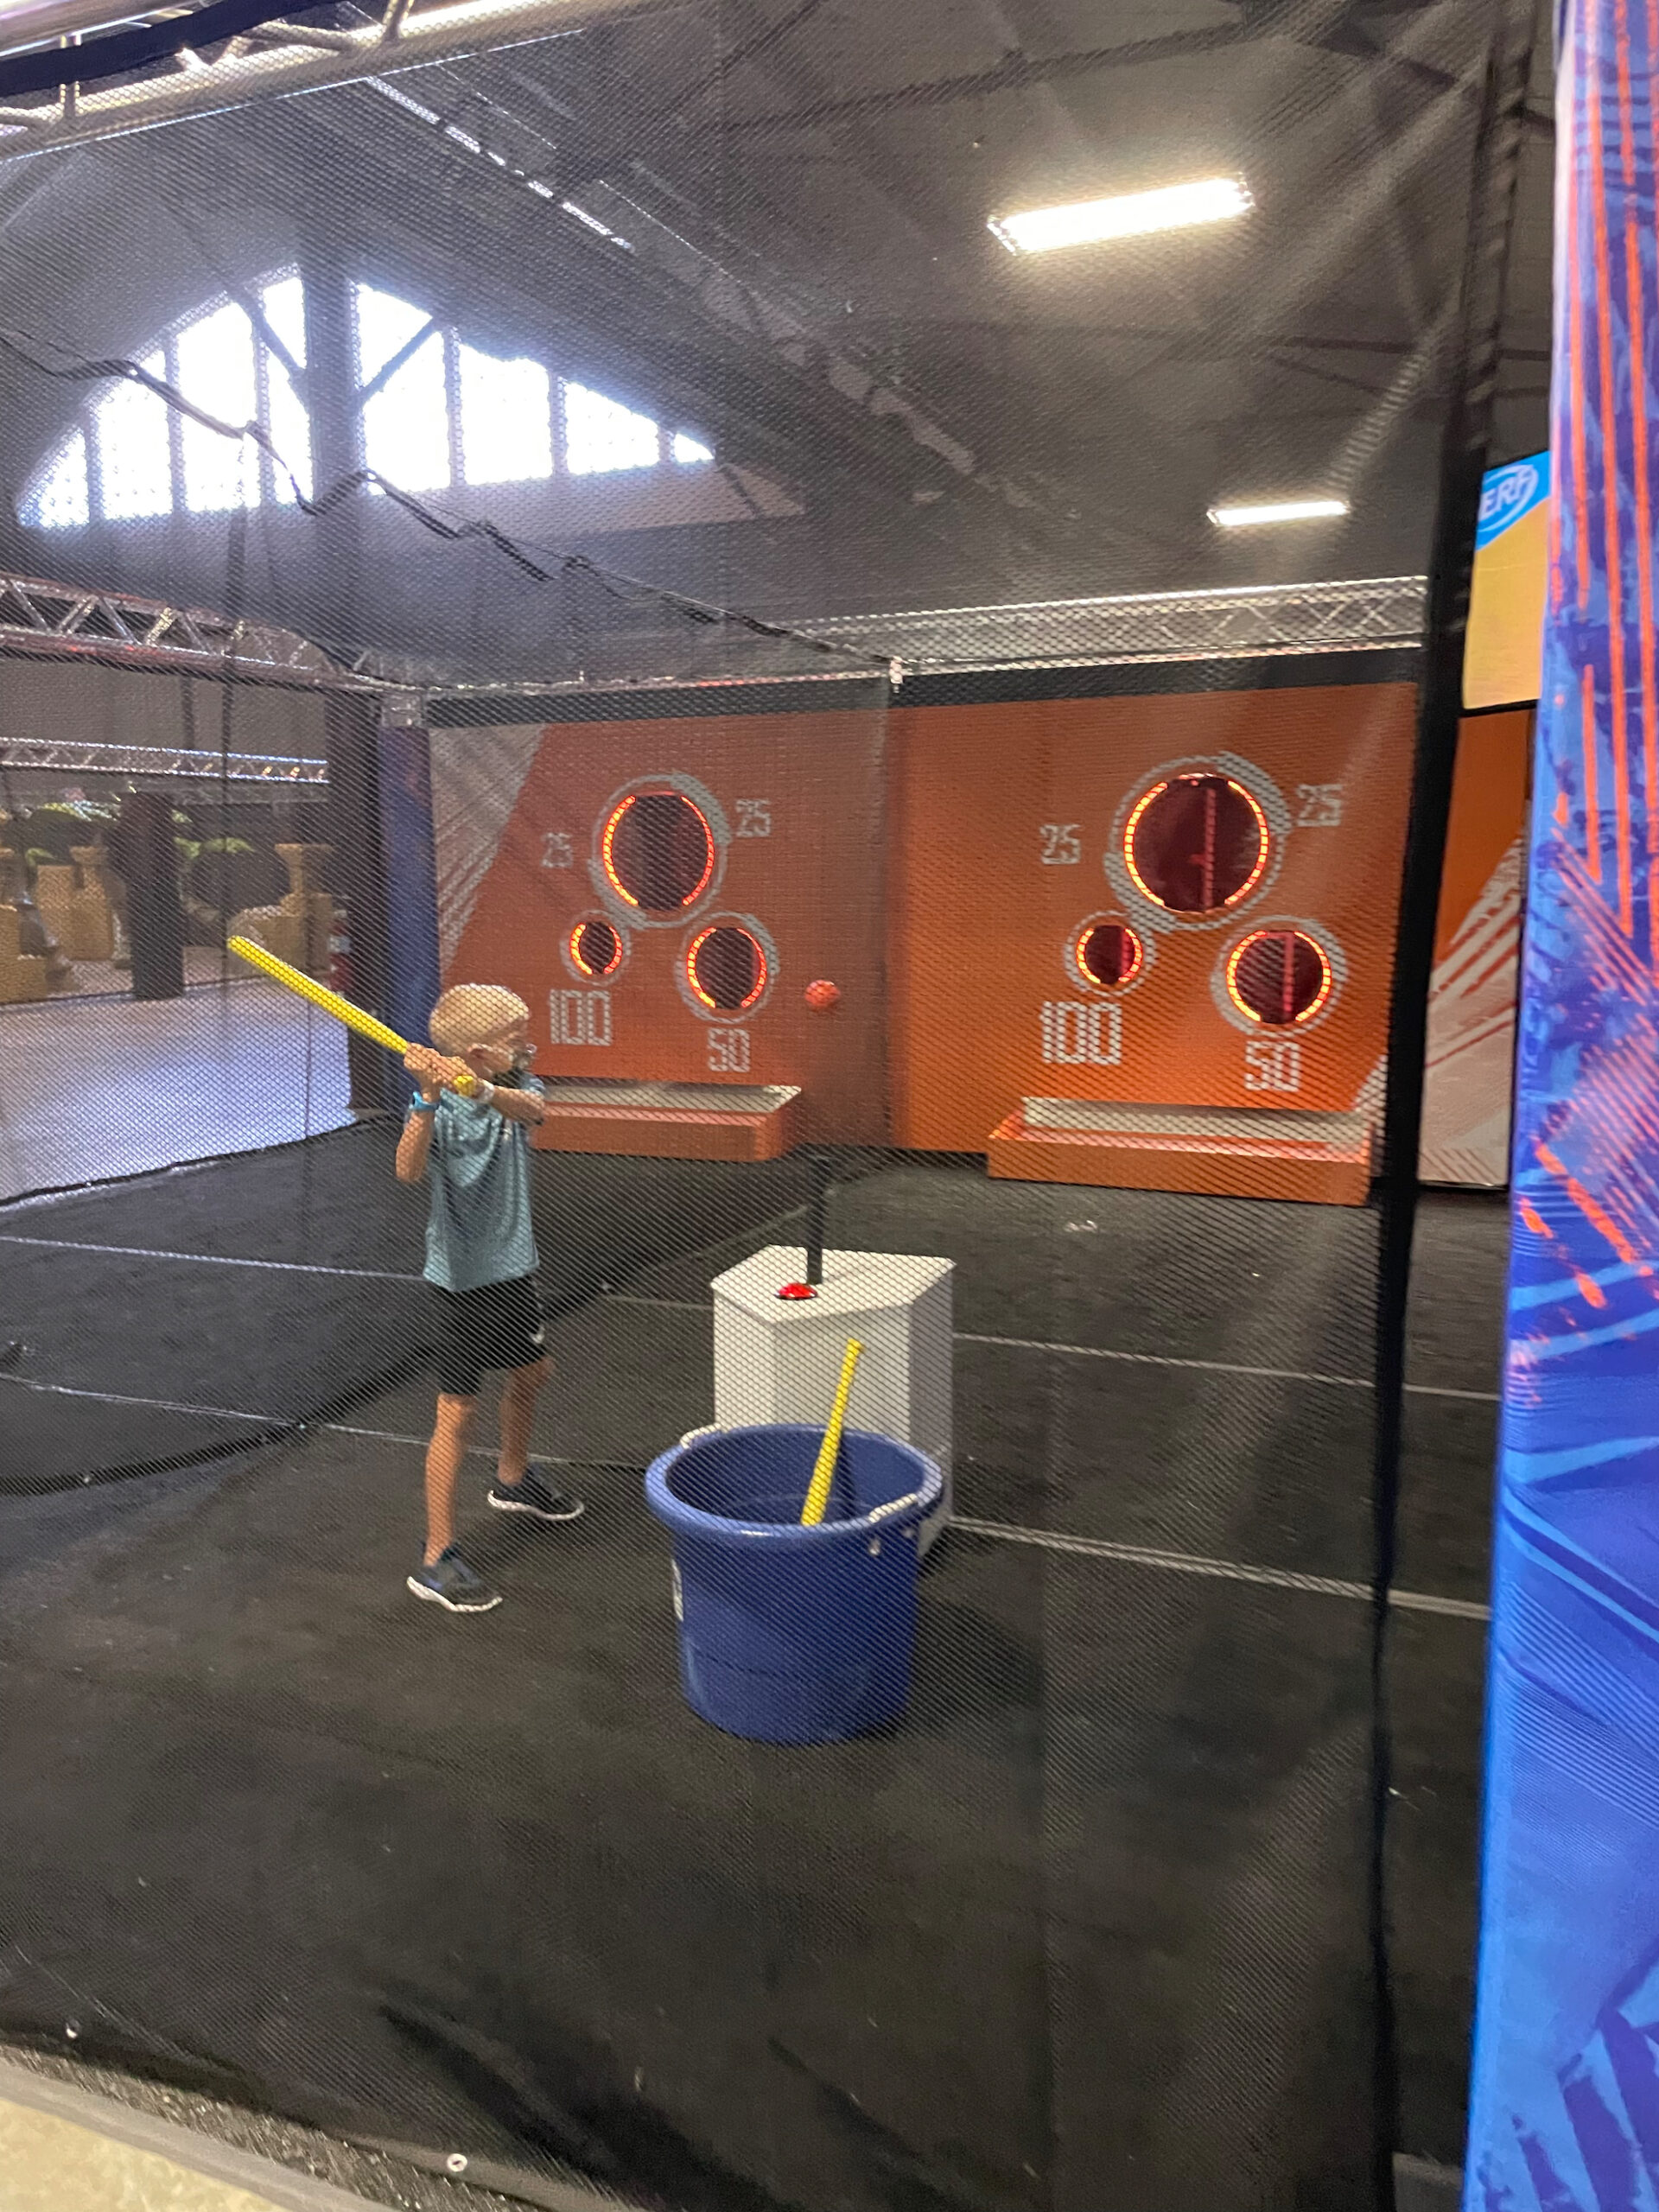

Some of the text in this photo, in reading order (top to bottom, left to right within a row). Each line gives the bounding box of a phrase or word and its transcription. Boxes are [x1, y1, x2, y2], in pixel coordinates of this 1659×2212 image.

[1478, 468, 1535, 521] ERF
[736, 798, 772, 838] 25
[1296, 783, 1344, 828] 25
[541, 831, 573, 868] 25
[1039, 823, 1082, 866] 25
[548, 988, 612, 1046] 100
[1039, 1001, 1122, 1065] 100
[707, 1027, 751, 1073] 50
[1243, 1040, 1300, 1093] 50
